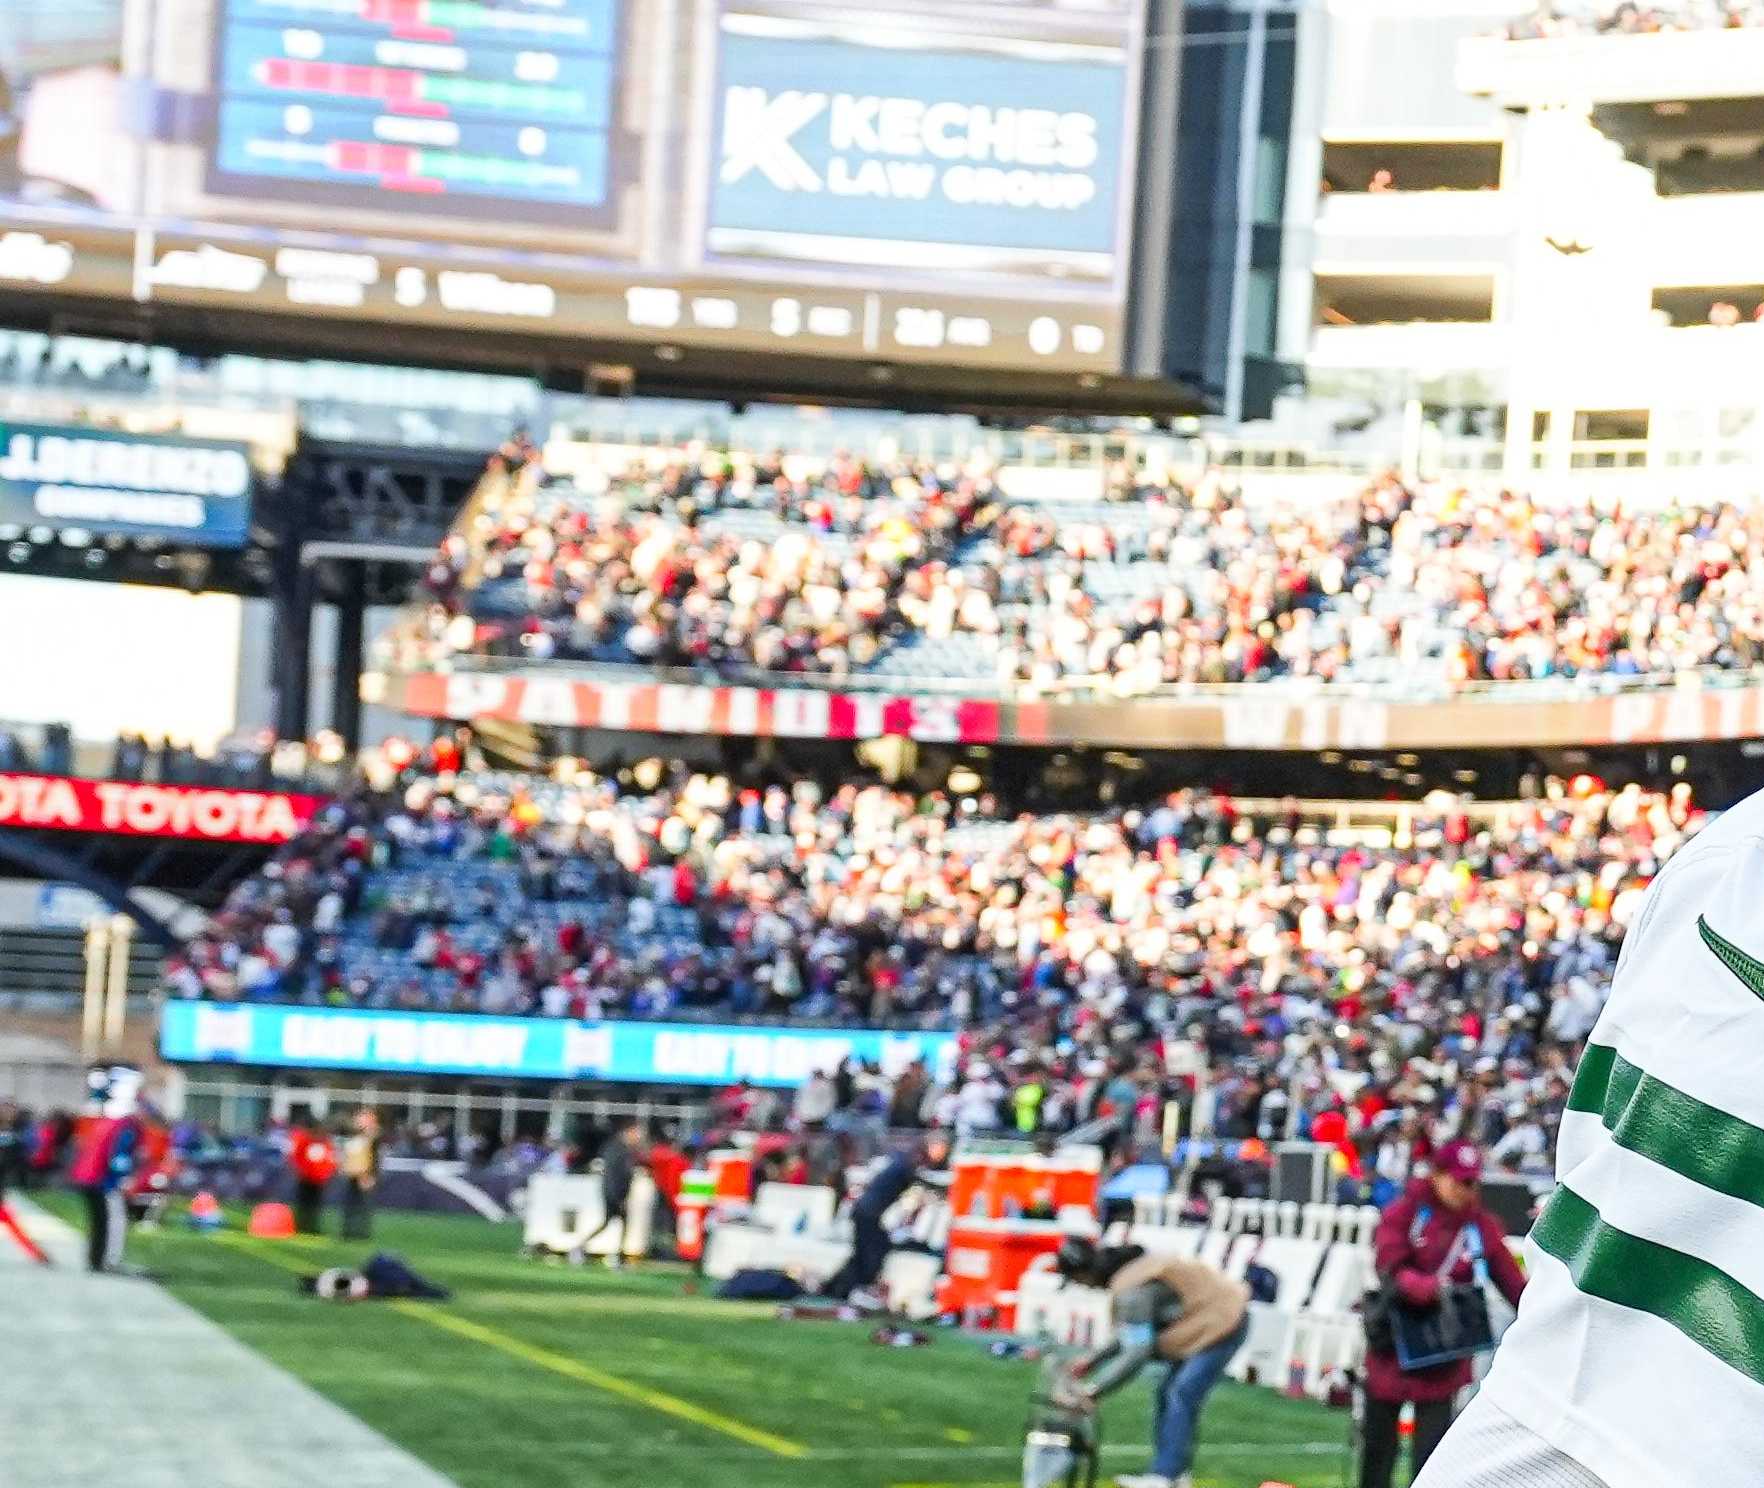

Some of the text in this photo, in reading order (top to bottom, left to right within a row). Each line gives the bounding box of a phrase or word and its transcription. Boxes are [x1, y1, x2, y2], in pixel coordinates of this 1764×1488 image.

[830, 93, 1099, 169] KECHES
[827, 156, 937, 201] LAW
[1222, 697, 1390, 748] WIN
[95, 783, 300, 841] TOYOTA
